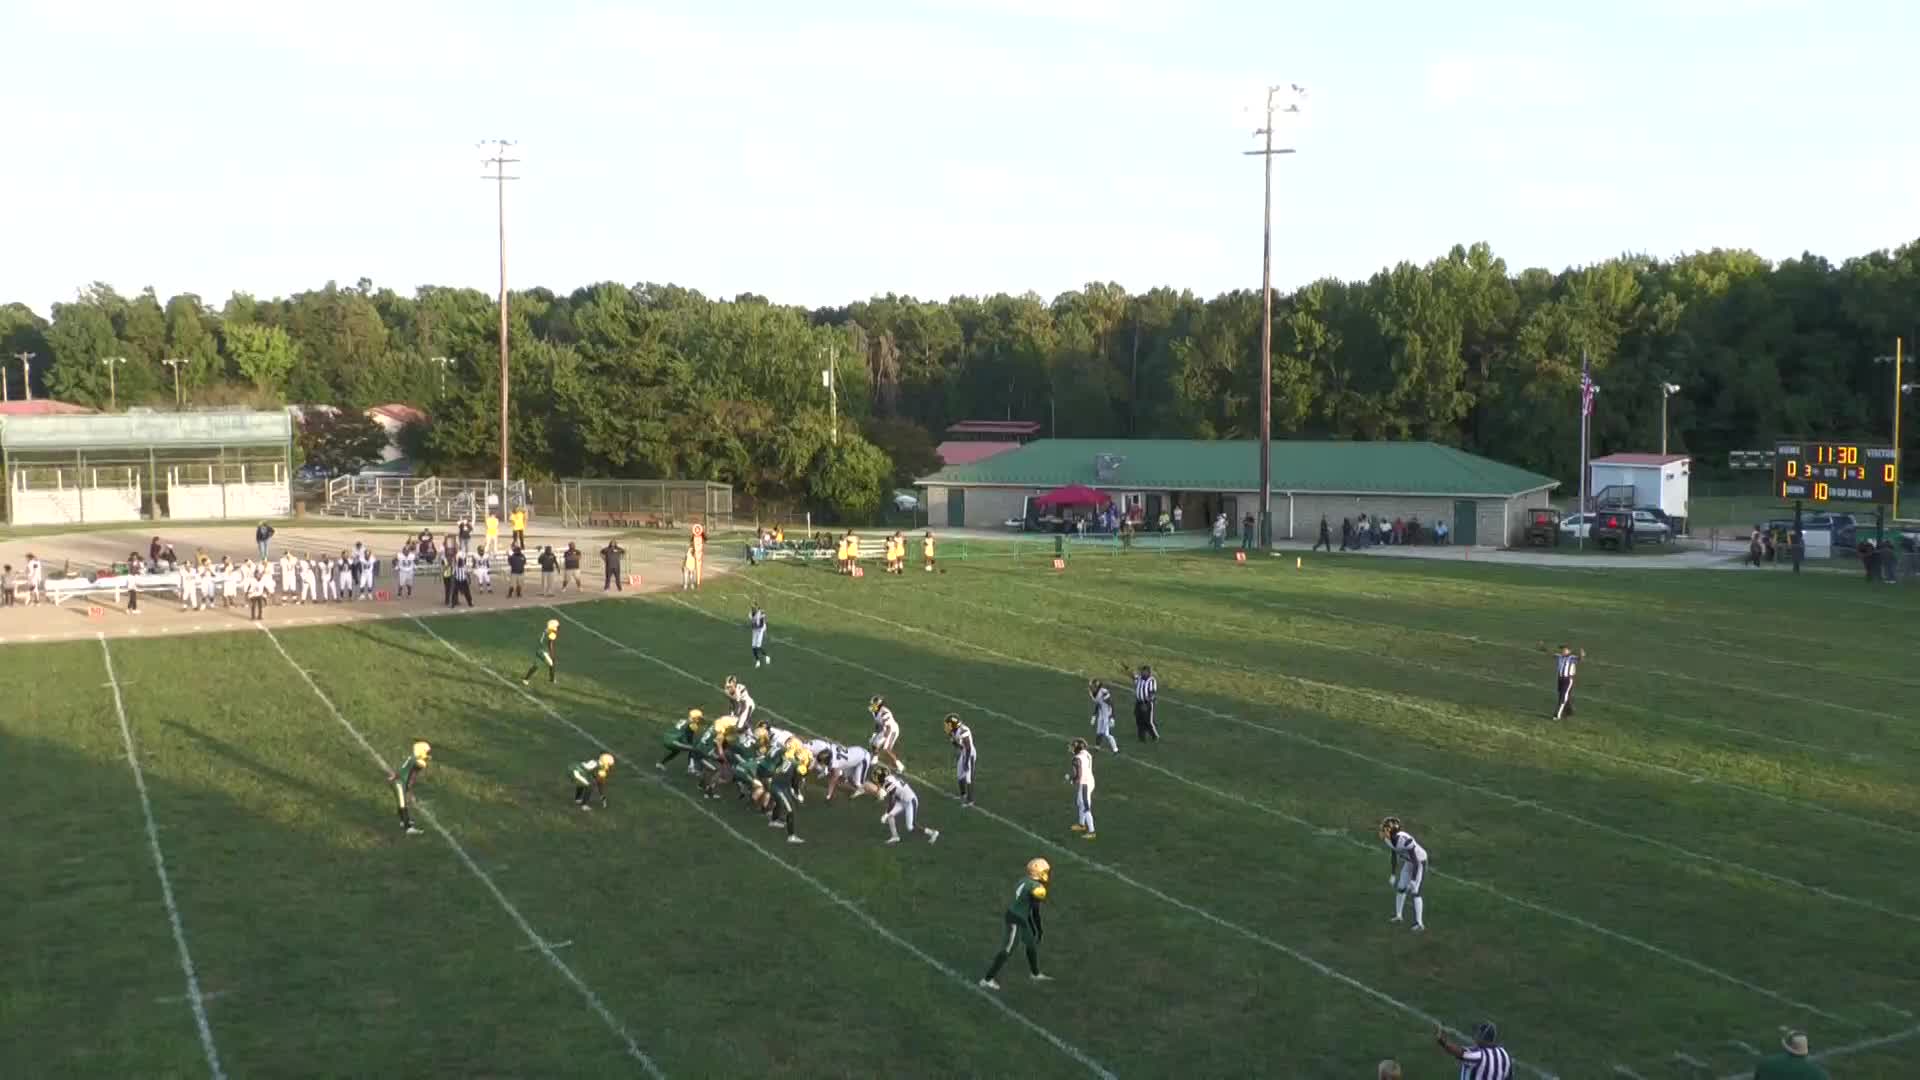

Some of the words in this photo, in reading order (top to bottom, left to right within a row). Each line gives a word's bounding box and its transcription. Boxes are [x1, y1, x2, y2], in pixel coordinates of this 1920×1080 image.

[1818, 446, 1857, 464] 11:30
[1787, 460, 1797, 477] 0
[1804, 464, 1811, 477] 3
[1857, 467, 1865, 480] 3
[1884, 464, 1895, 482] 0
[1814, 482, 1828, 500] 10
